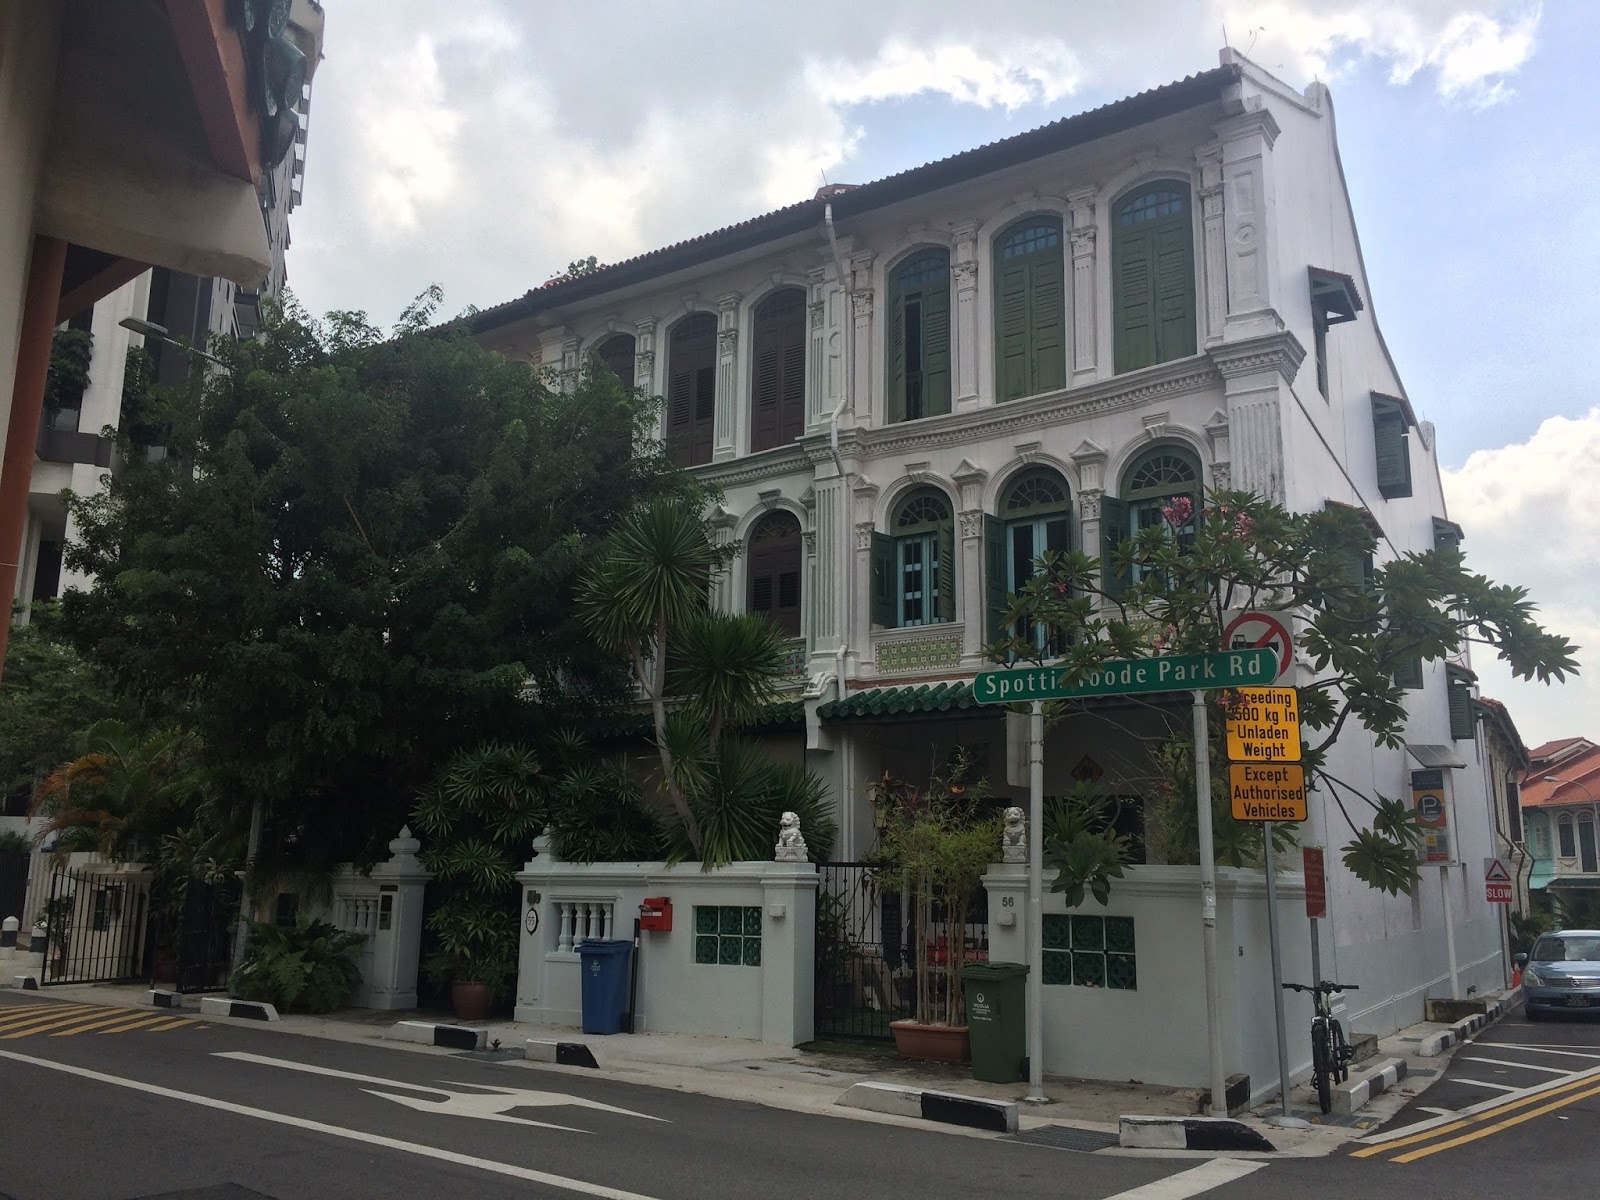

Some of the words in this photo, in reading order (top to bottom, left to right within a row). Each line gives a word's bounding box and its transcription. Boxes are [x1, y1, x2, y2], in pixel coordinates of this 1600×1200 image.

[986, 664, 1147, 698] Spottioode
[1159, 657, 1215, 682] Park
[1229, 654, 1261, 677] Rd
[1265, 707, 1279, 725] kg
[1237, 724, 1289, 739] Unladen
[1243, 742, 1286, 760] Weight
[1245, 766, 1288, 785] Except
[1234, 785, 1303, 800] Authorised
[1243, 803, 1295, 818] Vehicles
[1421, 796, 1438, 815] P
[1002, 896, 1014, 907] 56
[1487, 888, 1512, 899] SLOW
